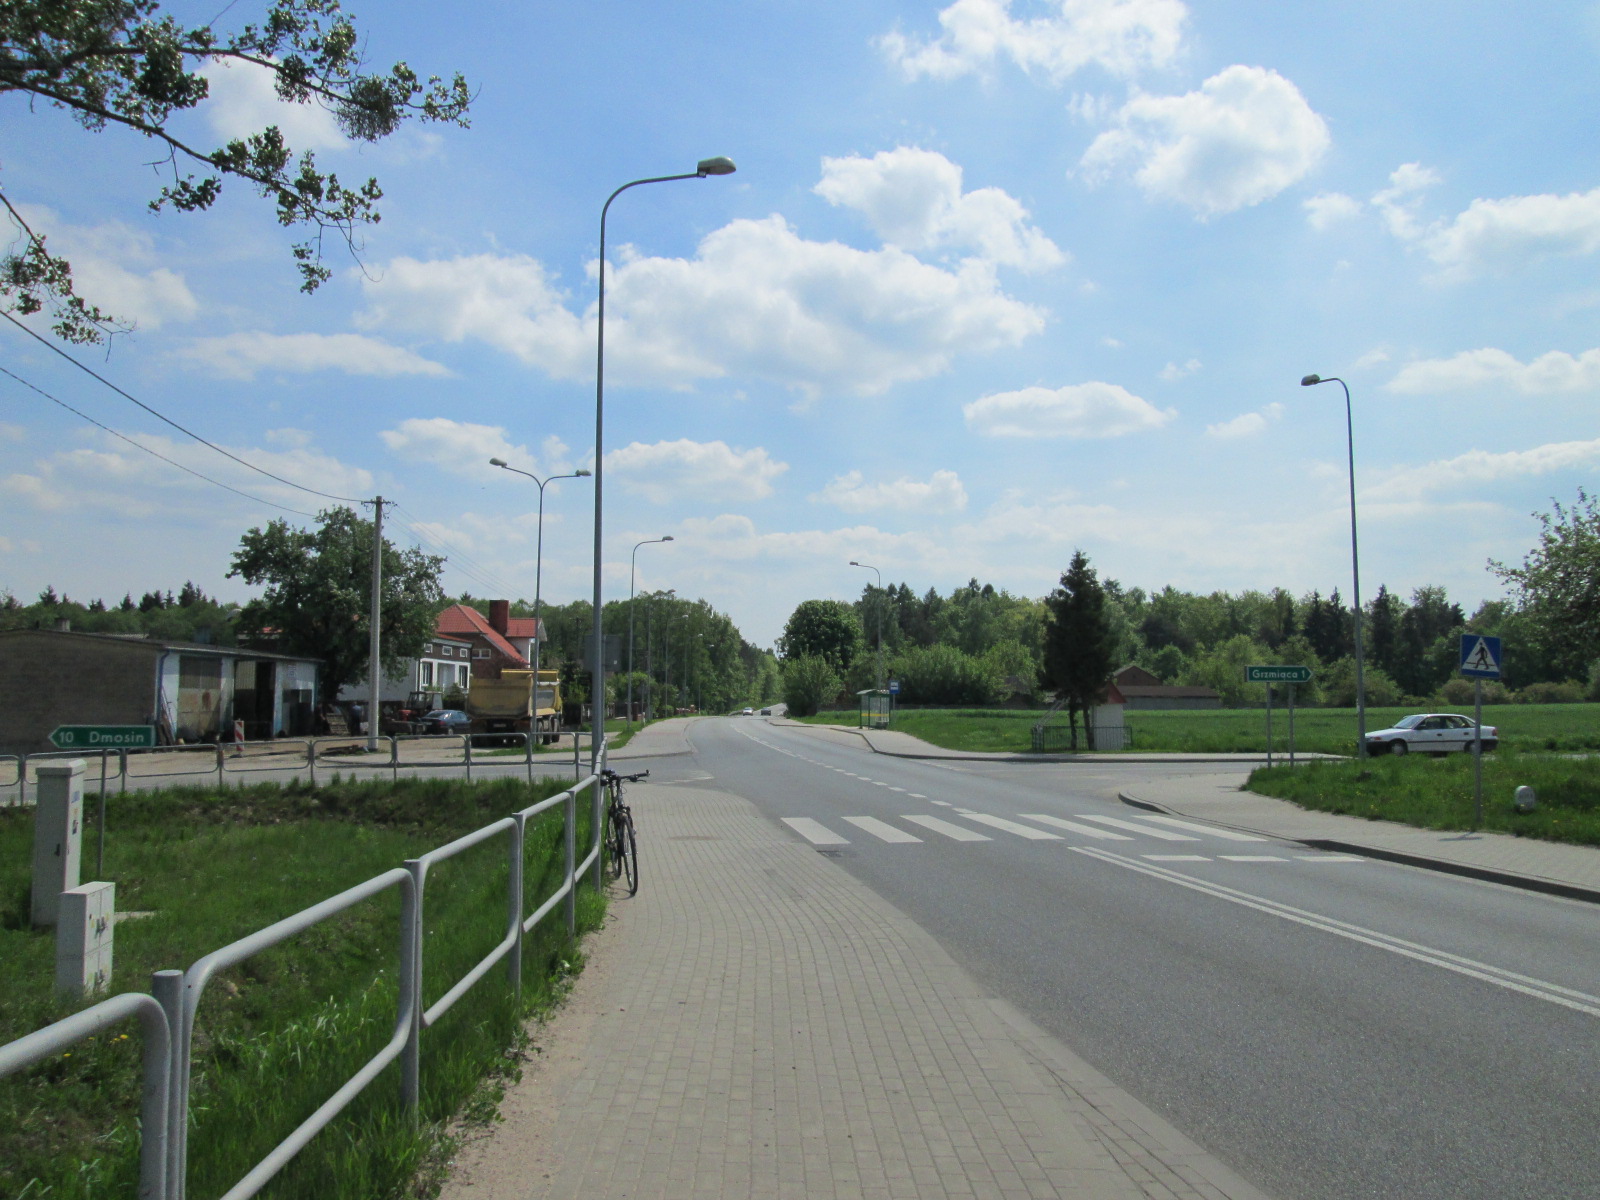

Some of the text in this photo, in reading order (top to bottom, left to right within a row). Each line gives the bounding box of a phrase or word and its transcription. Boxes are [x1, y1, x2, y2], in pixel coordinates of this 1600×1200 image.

[1252, 669, 1306, 681] Grzmiąca 1
[59, 731, 144, 743] 10 Dmosin
